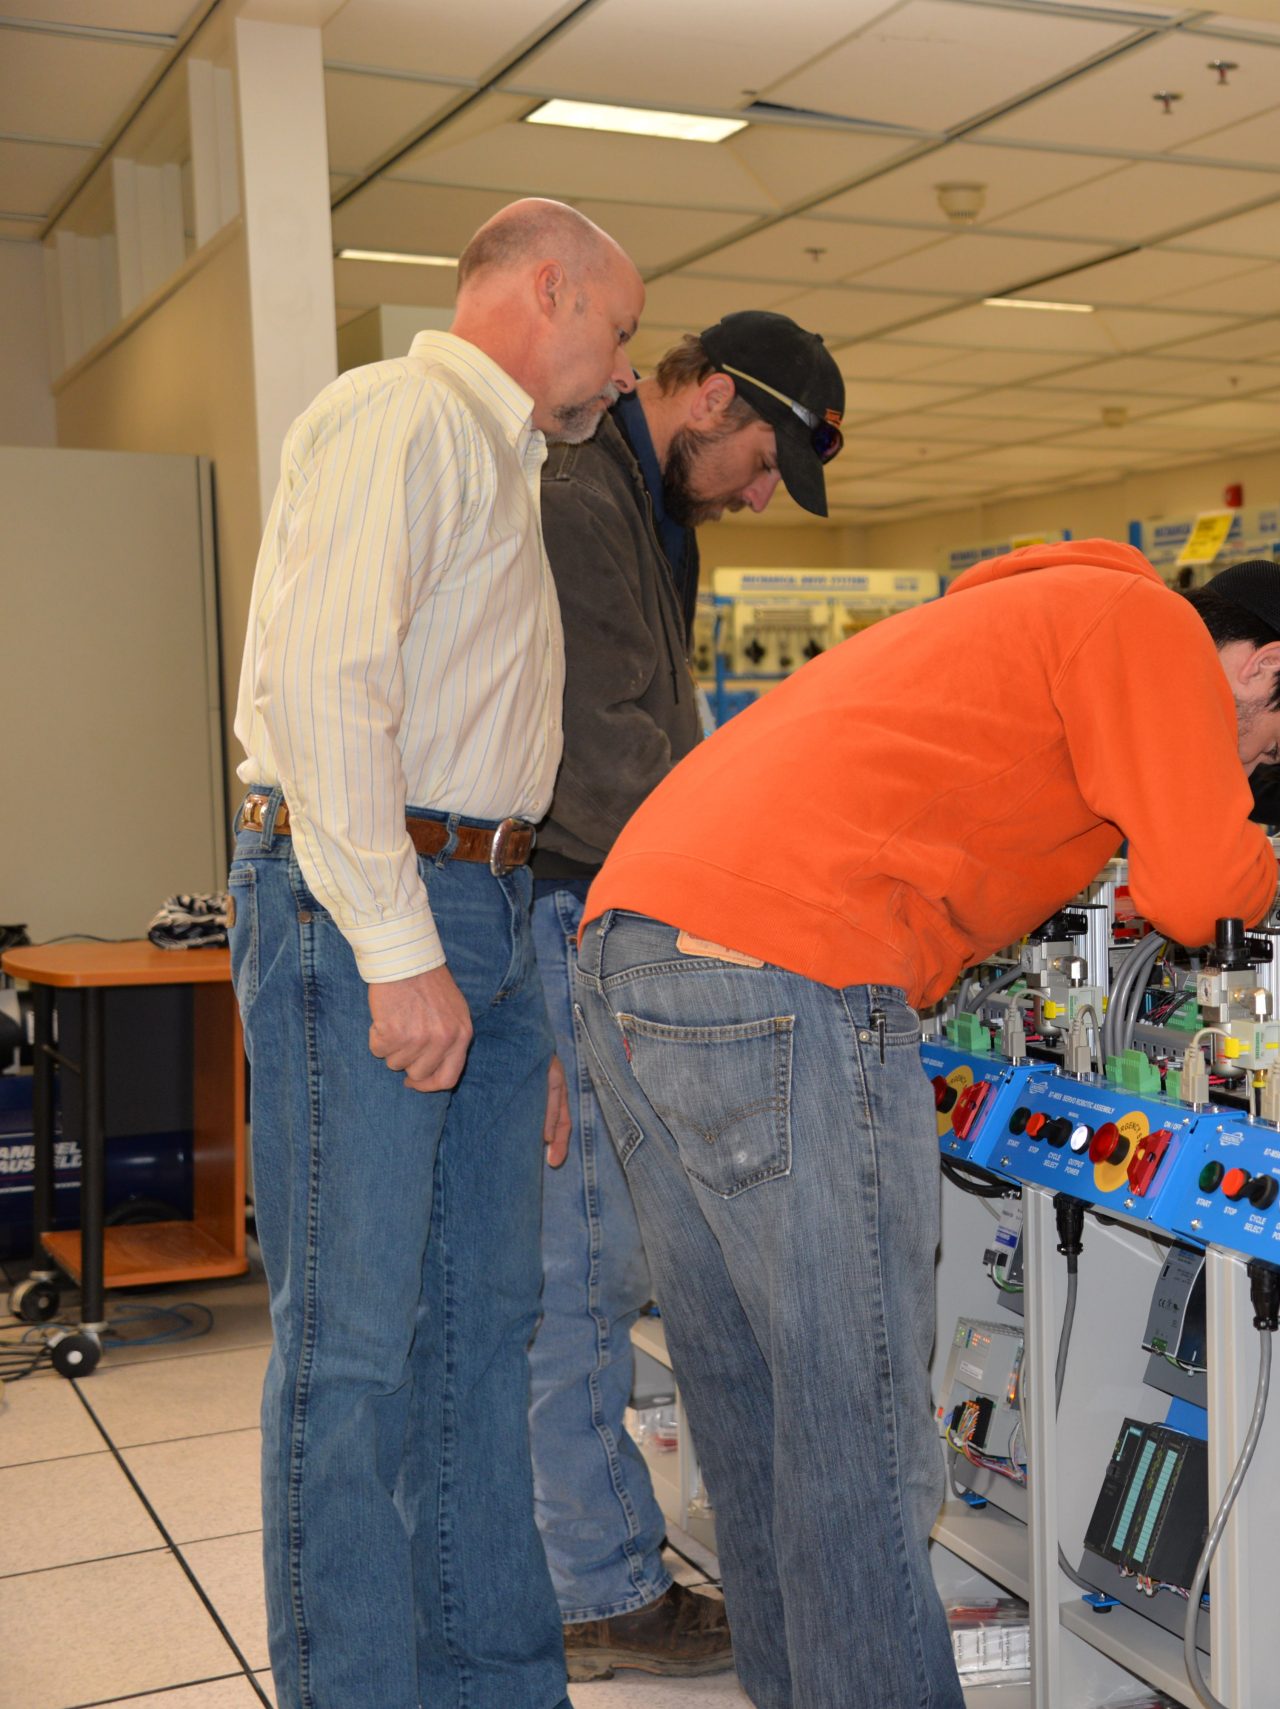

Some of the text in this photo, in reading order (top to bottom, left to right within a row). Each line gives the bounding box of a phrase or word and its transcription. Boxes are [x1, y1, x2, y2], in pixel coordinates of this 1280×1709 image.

[1047, 1152, 1061, 1161] CYCLE
[1043, 1159, 1059, 1169] SELECT
[1068, 1158, 1085, 1168] OUTPUT
[1064, 1166, 1080, 1176] POWER
[1196, 1197, 1212, 1208] START
[1224, 1206, 1237, 1216] STOP
[1249, 1214, 1267, 1225] CYCLE
[1244, 1222, 1264, 1234] SELECT
